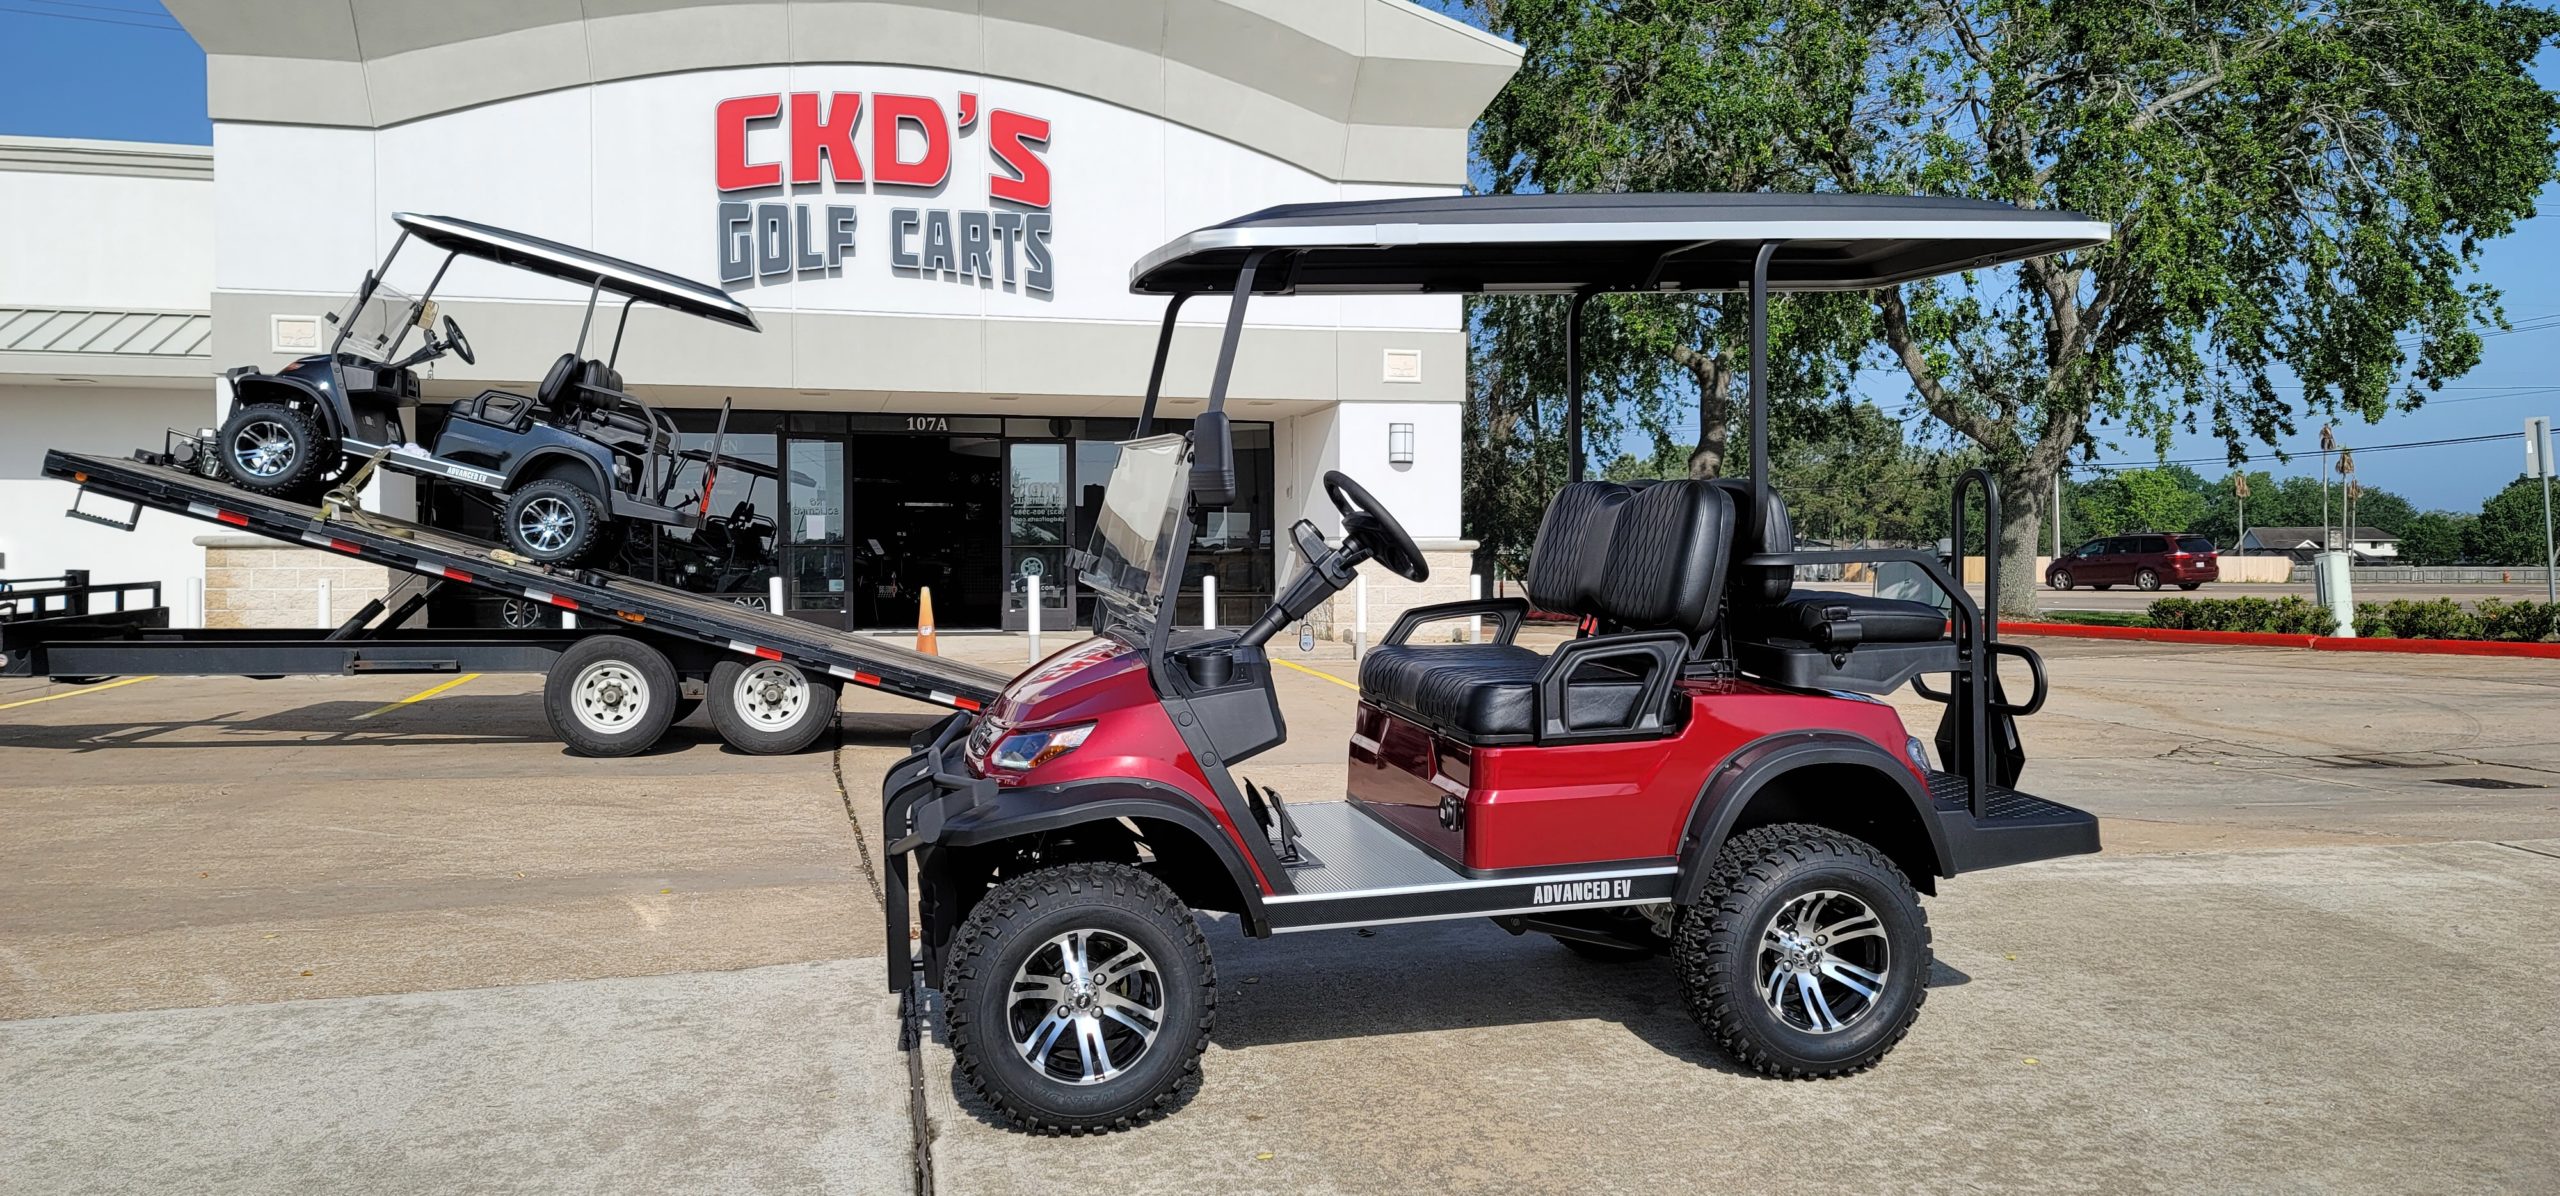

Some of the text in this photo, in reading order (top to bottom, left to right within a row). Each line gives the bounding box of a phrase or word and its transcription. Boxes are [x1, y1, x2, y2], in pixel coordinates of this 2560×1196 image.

[714, 91, 1052, 208] CKD'S
[718, 201, 1055, 293] GOLF CARTS
[906, 416, 948, 431] 107A
[704, 440, 737, 452] OEN
[1533, 879, 1632, 905] ADVANCED EV
